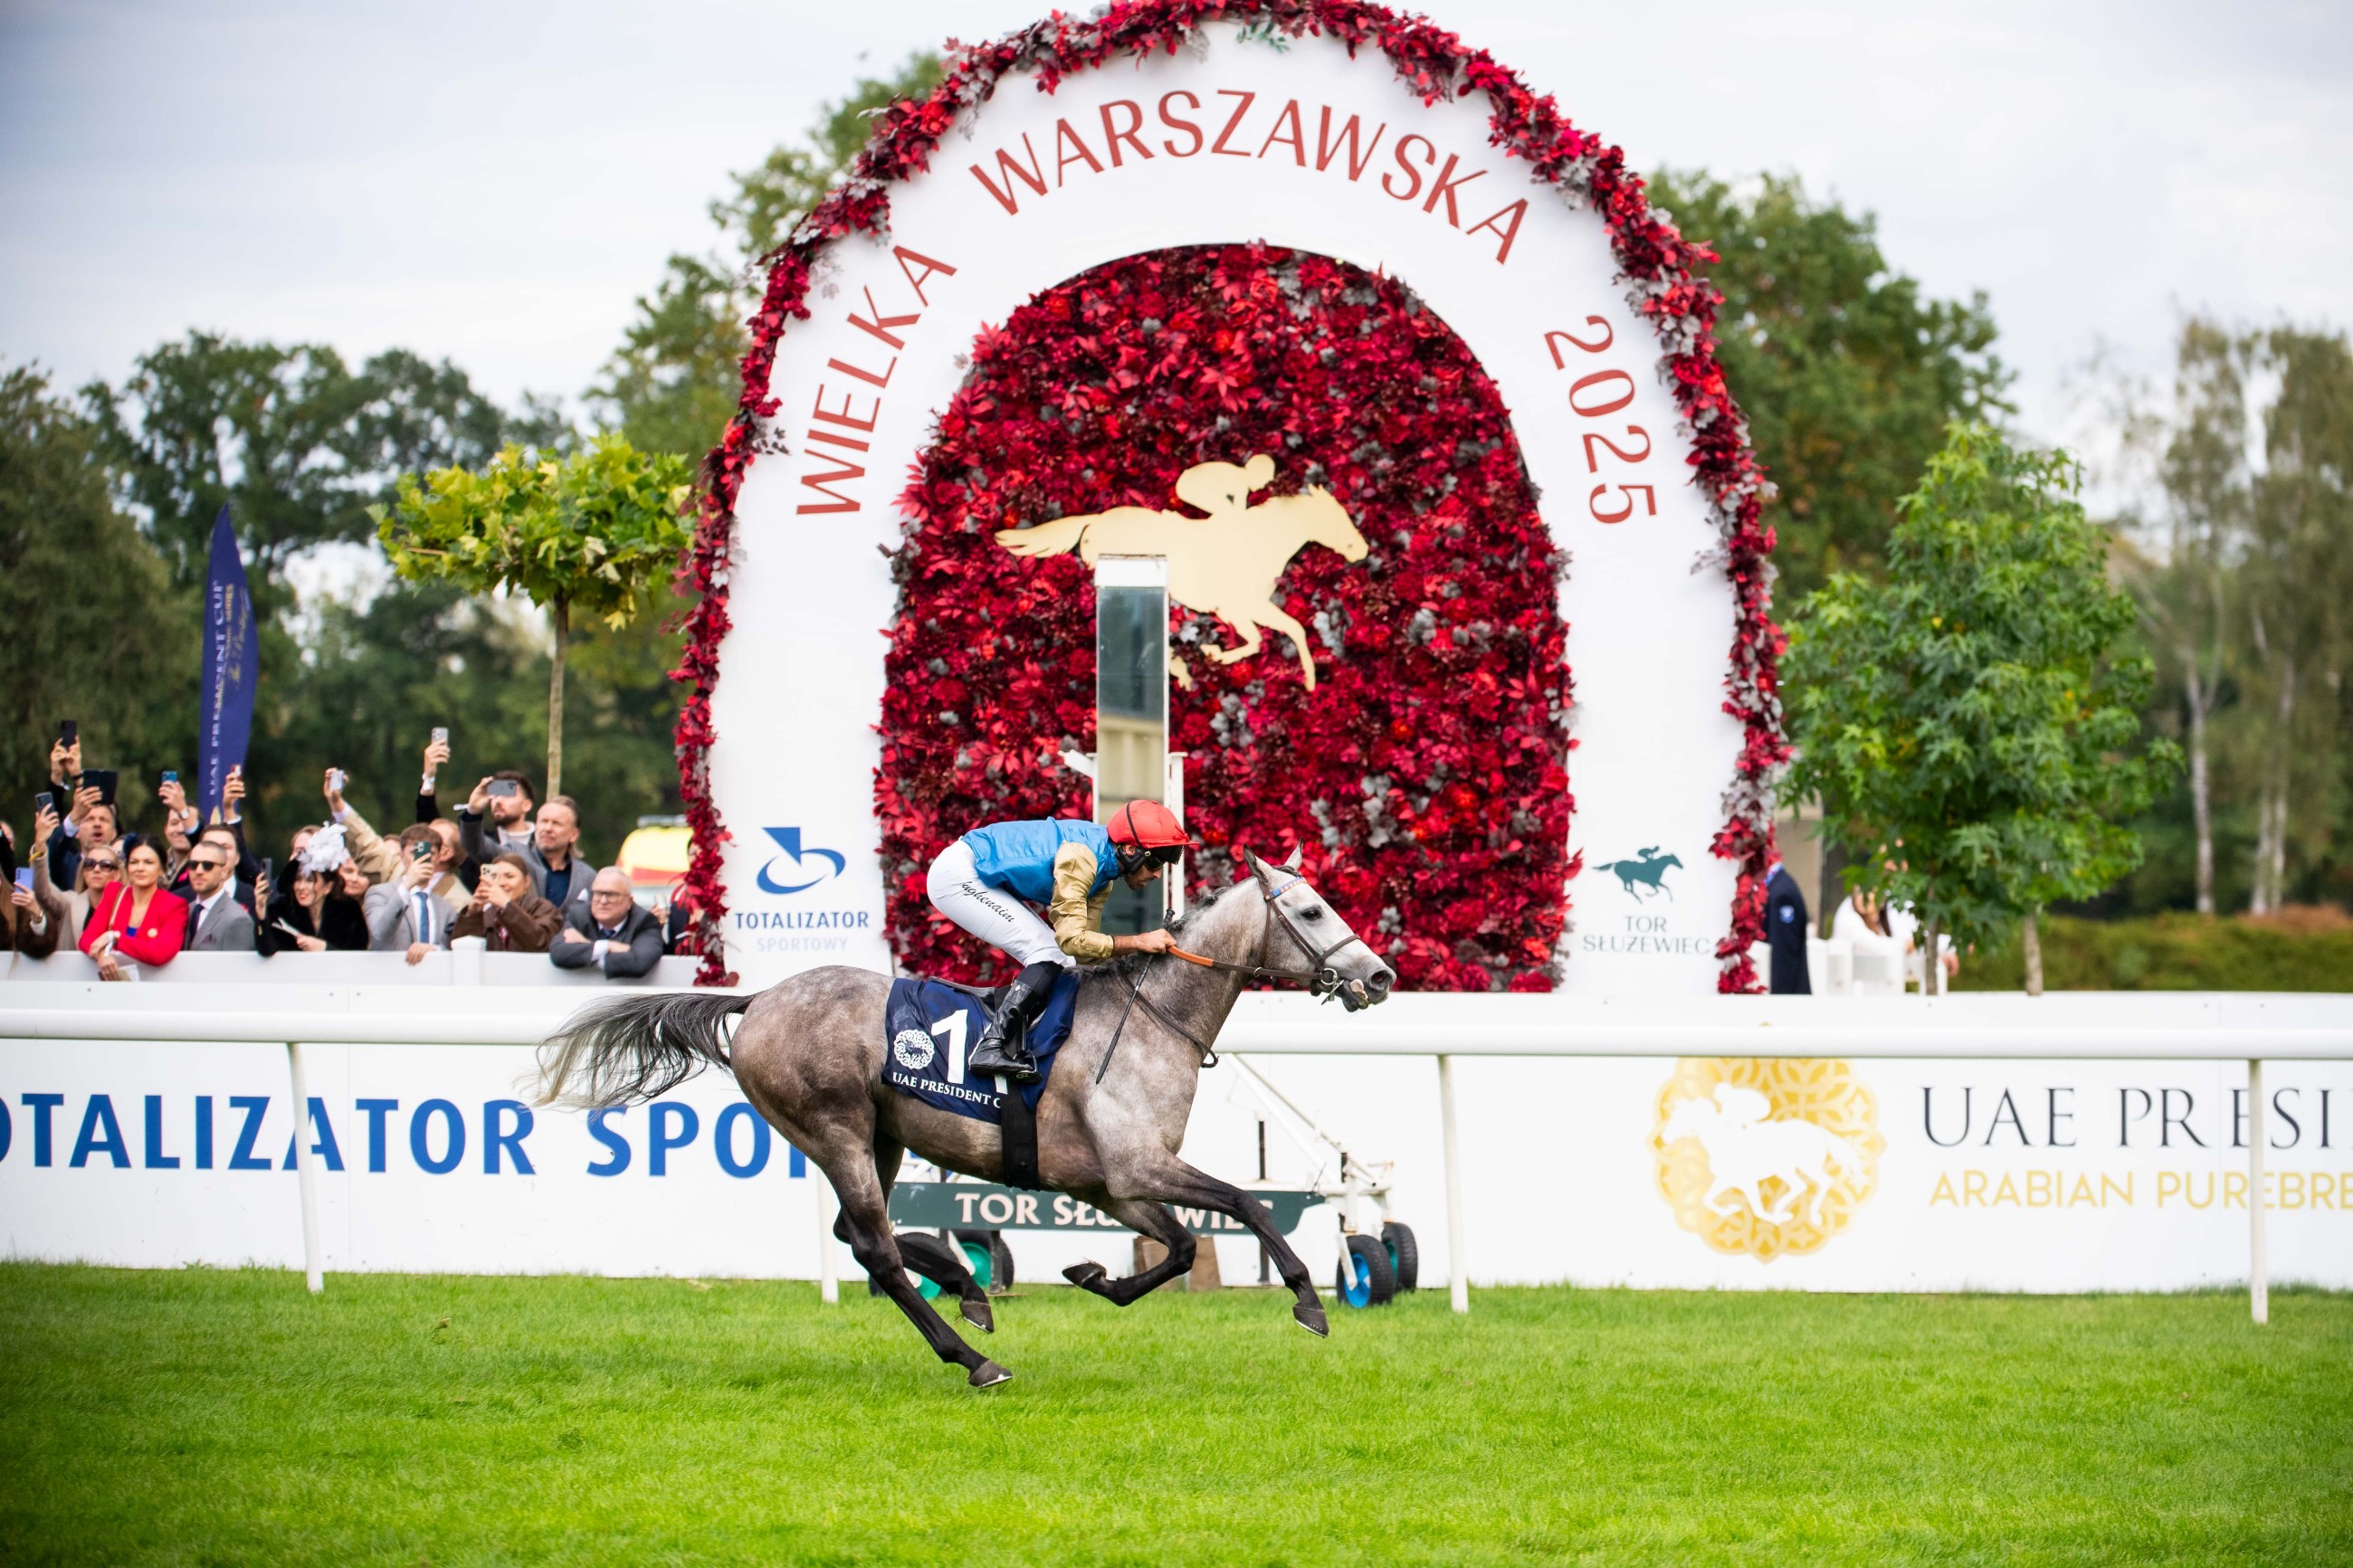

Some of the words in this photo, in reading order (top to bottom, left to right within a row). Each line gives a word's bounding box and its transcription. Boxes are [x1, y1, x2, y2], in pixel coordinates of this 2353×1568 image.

[795, 245, 957, 515] WIELKA
[970, 89, 1529, 264] WARSZAWSKA
[1544, 314, 1657, 525] 2025
[735, 911, 869, 930] TOTALIZATOR
[1625, 916, 1667, 933] TOR
[757, 936, 849, 952] SPORTOWY
[892, 1071, 918, 1088] UAE
[919, 1079, 992, 1106] PRESIDENT
[0, 1093, 536, 1175] TALIZATOR
[586, 1100, 806, 1179] SPO
[1921, 1087, 2077, 1147] UAE
[2117, 1088, 2353, 1150] PRESI
[1929, 1170, 2134, 1209] ARABIAN
[954, 1193, 1041, 1225] TOR
